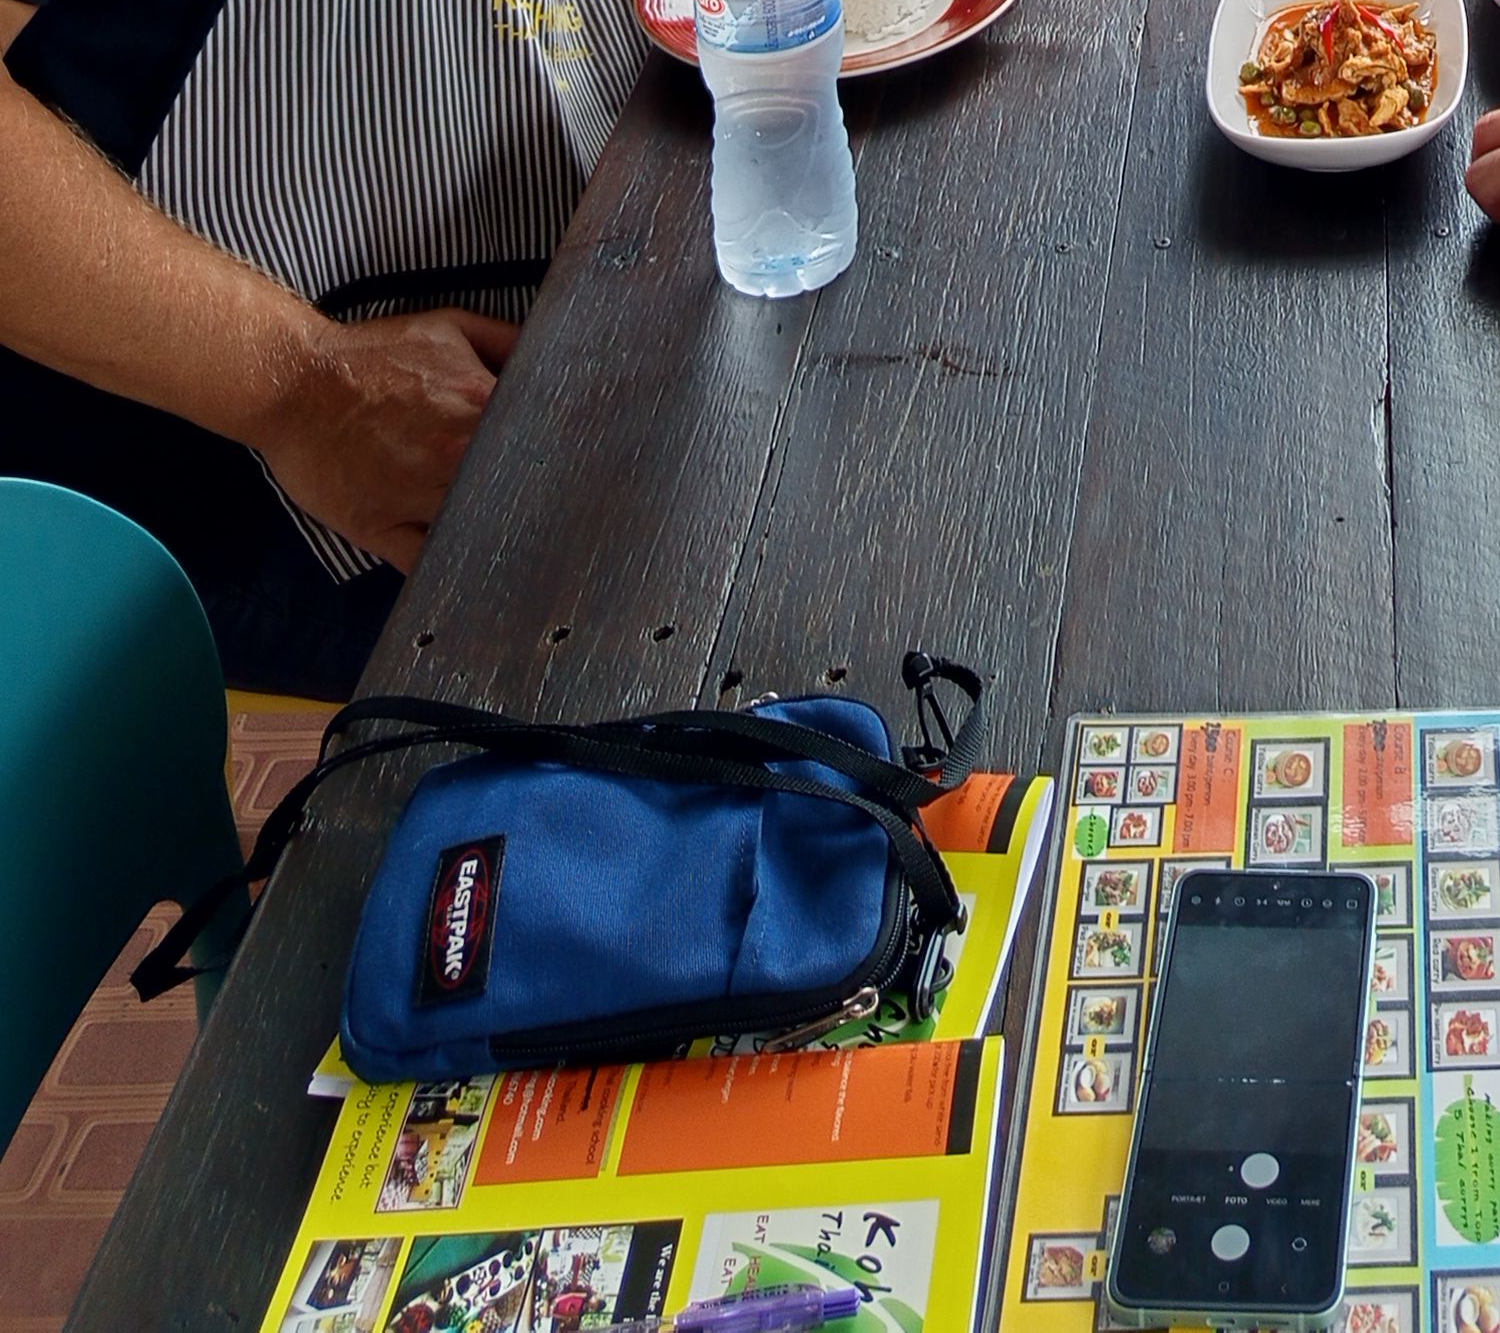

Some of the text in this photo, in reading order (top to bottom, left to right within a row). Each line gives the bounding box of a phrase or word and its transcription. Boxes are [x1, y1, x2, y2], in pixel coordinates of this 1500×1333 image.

[444, 859, 479, 976] EASTPAK
[753, 1214, 769, 1245] EAT
[1225, 1196, 1248, 1205] FOTO
[814, 1211, 843, 1270] Thai
[854, 1211, 901, 1304] Koh
[648, 1243, 676, 1312] We are the
[721, 1257, 737, 1287] EAT
